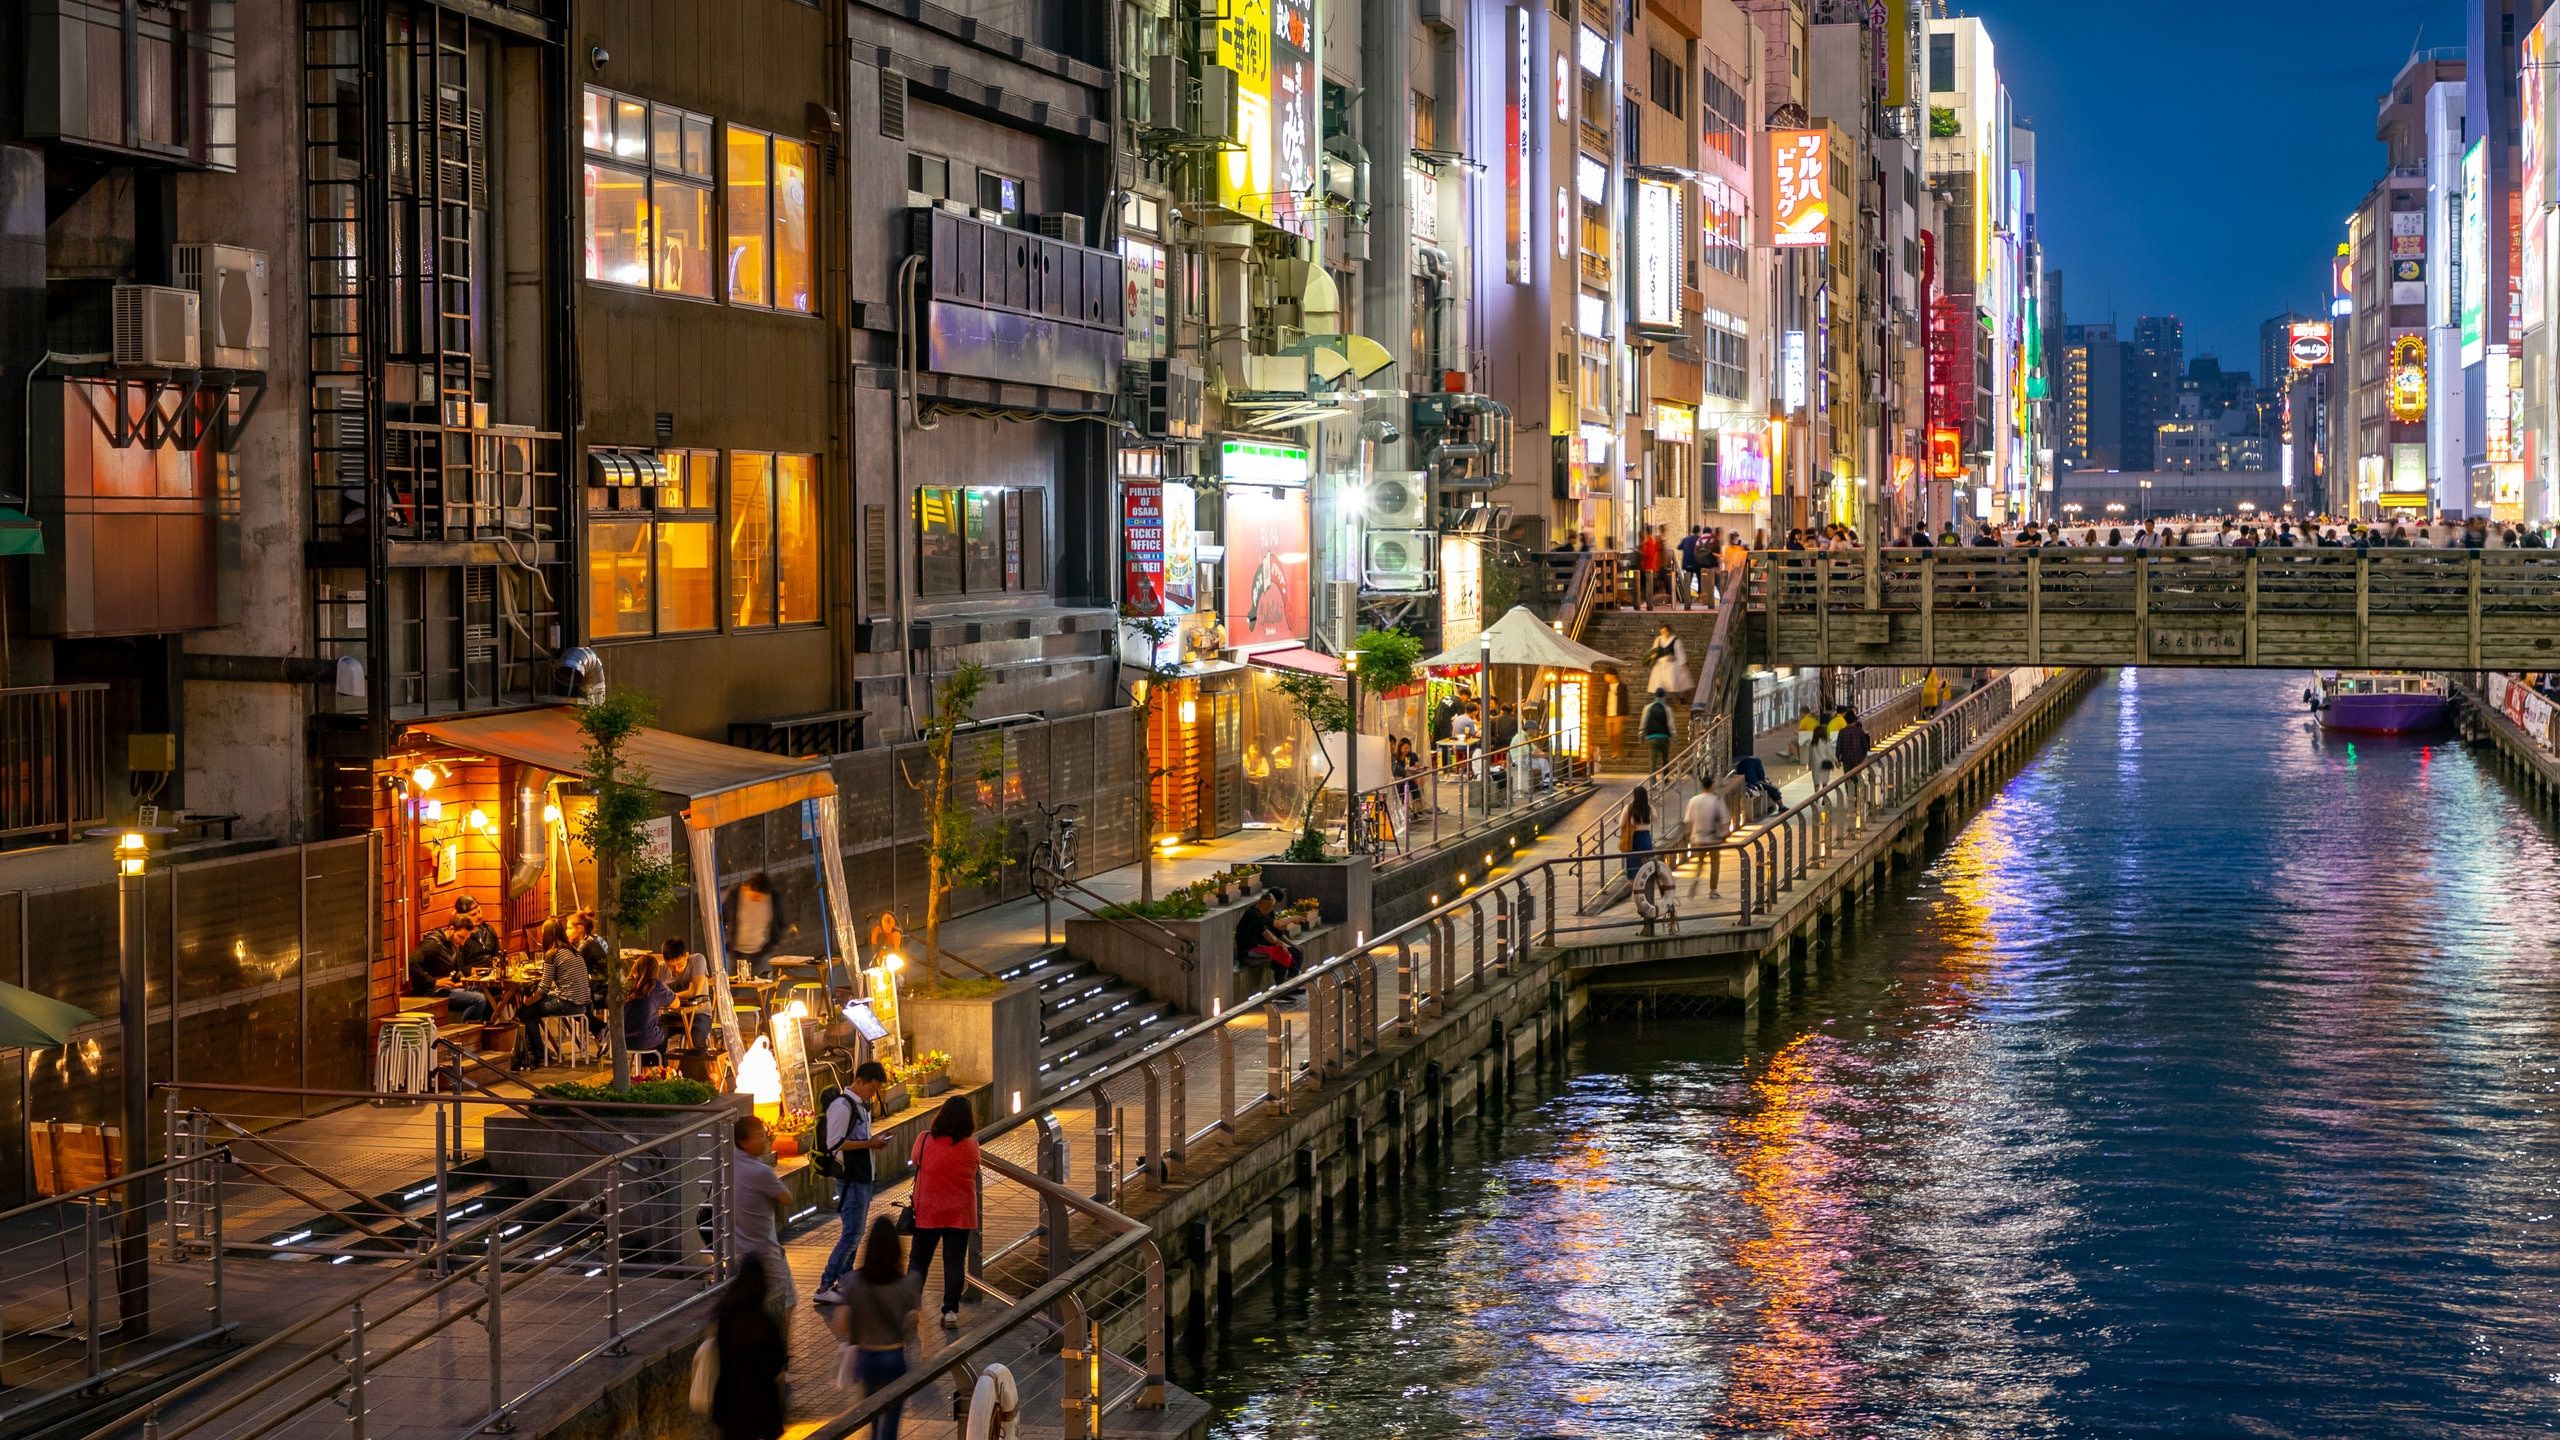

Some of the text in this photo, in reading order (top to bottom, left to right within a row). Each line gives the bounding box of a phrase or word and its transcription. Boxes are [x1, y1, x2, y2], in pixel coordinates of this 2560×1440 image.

[1222, 16, 1267, 82] 一番搾り
[1797, 135, 1823, 200] ツルハ
[1777, 147, 1797, 217] ドラッグ
[1129, 487, 1162, 497] PIRATES
[1140, 497, 1151, 507] OF
[1132, 507, 1159, 517] OSAKA
[1130, 528, 1162, 539] TICKET
[1130, 540, 1161, 551] OFFICE
[1131, 562, 1160, 573] HERE!!
